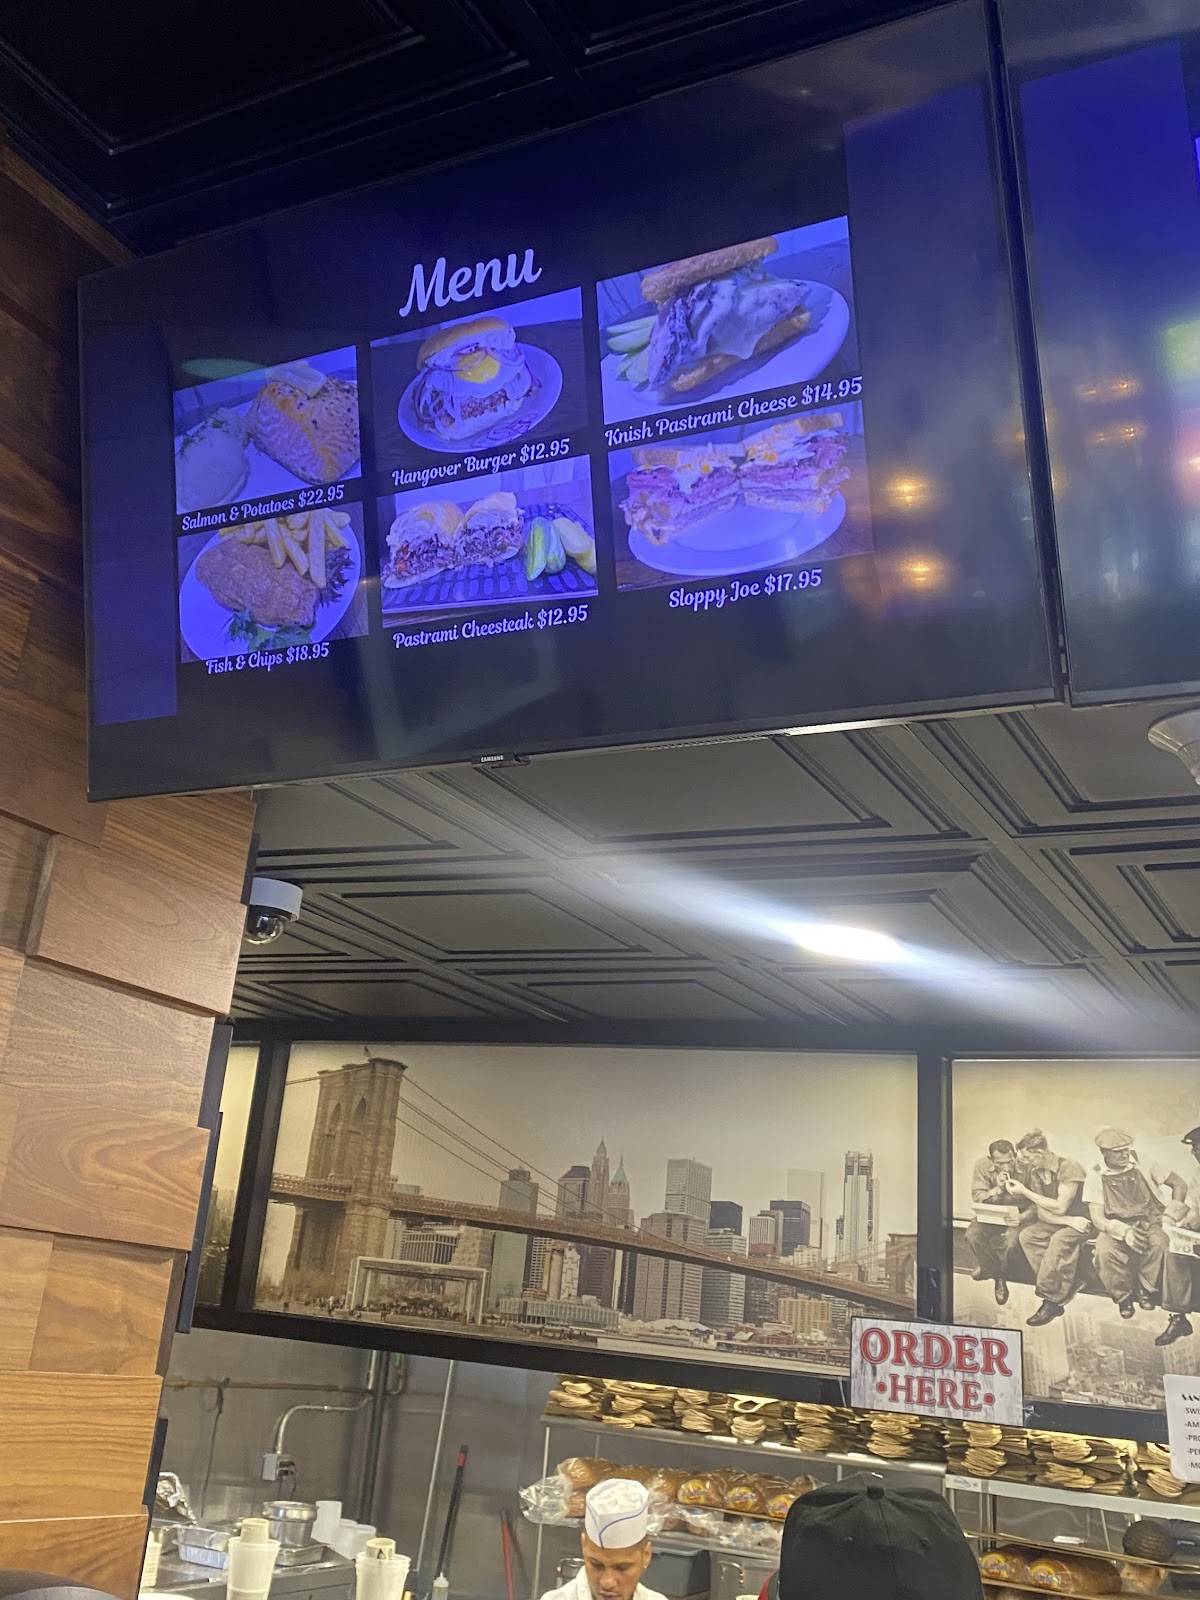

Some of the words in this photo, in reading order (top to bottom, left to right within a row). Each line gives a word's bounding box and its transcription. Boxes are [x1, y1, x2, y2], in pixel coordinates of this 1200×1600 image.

[399, 248, 542, 317] Menu
[604, 421, 653, 446] Knish
[655, 405, 734, 435] Pastrami
[737, 394, 798, 417] Cheese
[801, 376, 863, 405] $14.95
[391, 463, 462, 487] Hangover
[464, 452, 517, 473] Burger
[519, 438, 570, 464] $12.95
[182, 513, 227, 530] Salmon
[230, 506, 240, 521] &
[241, 498, 294, 519] Potatoes
[298, 485, 344, 507] $22.95
[669, 587, 728, 611] Sloppy
[730, 581, 761, 602] Joe
[764, 568, 822, 595] $17.95
[393, 624, 459, 648] Pastrami
[461, 611, 534, 638] Cheesteak
[537, 604, 588, 629] $12.95
[205, 656, 234, 674] Fish
[235, 654, 246, 670] &
[248, 651, 283, 672] Chips
[286, 642, 330, 664] $18.95
[860, 1327, 1013, 1377] ORDER
